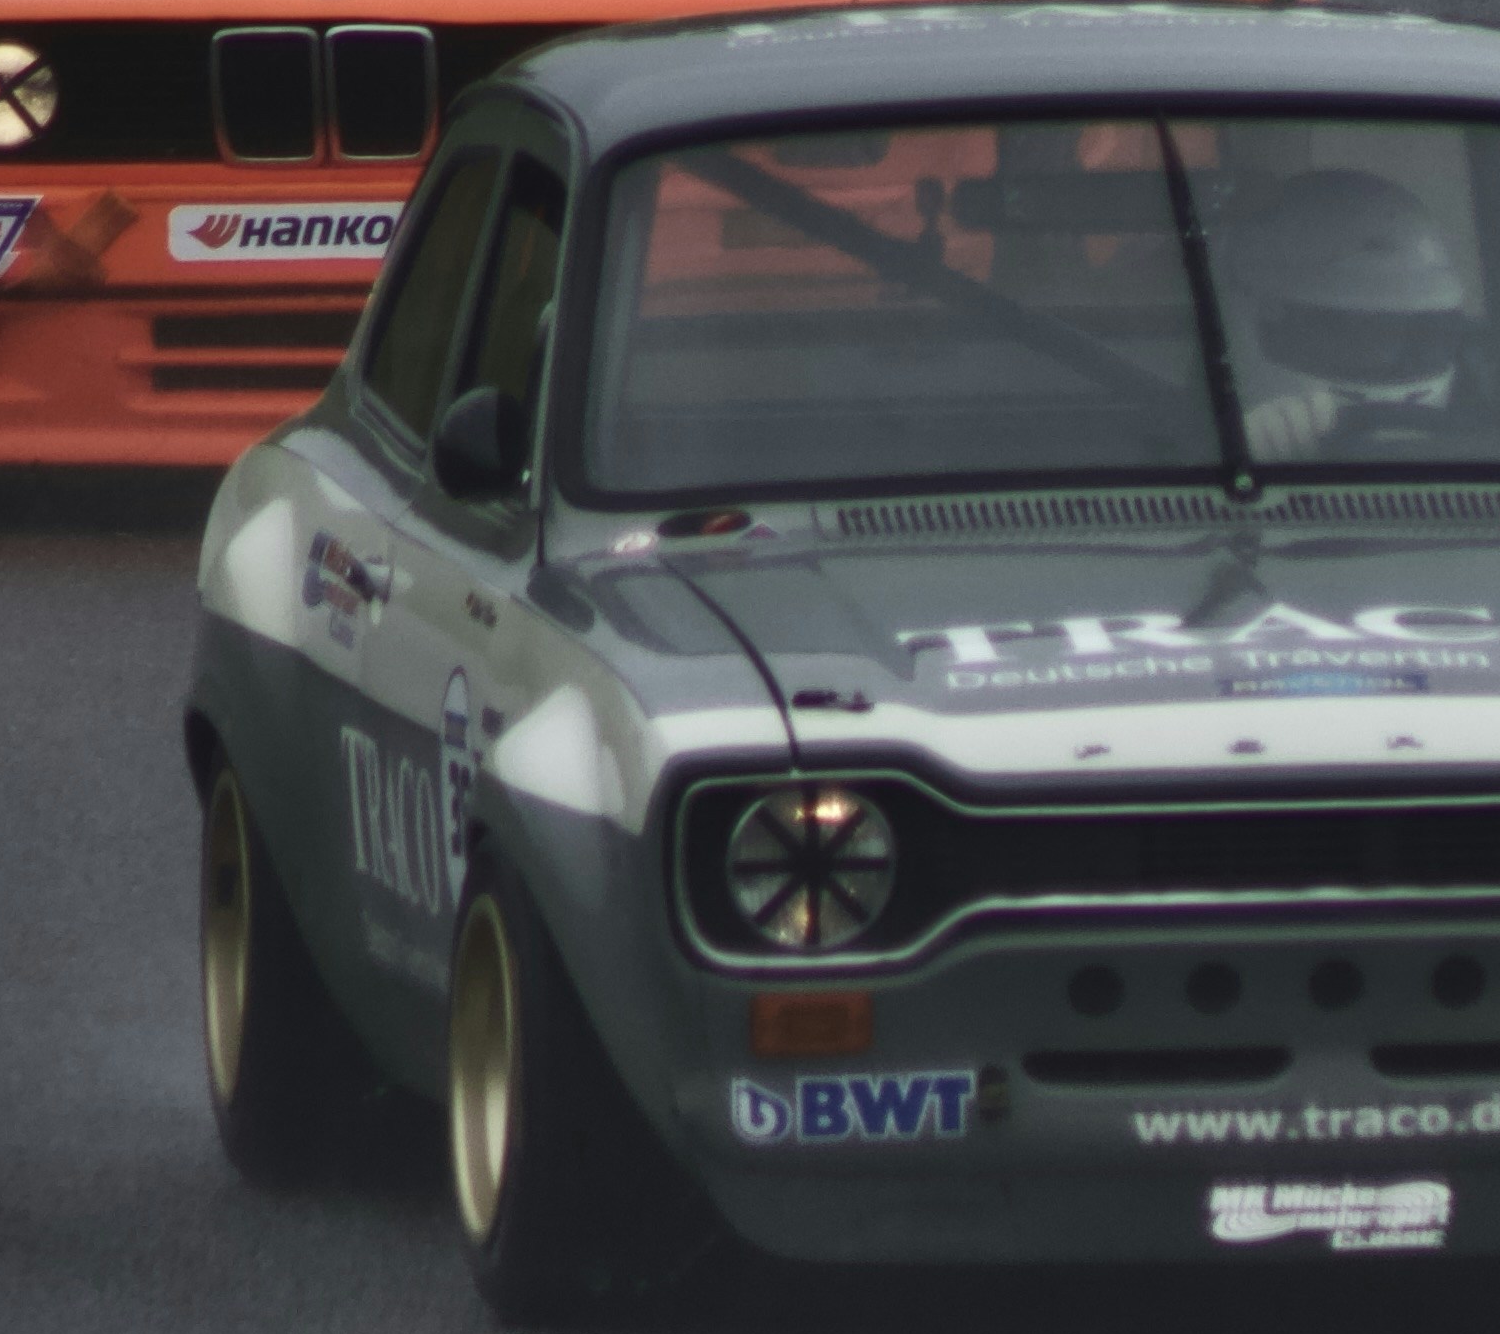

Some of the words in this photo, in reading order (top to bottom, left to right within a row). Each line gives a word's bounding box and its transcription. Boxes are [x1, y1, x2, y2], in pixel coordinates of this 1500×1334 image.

[947, 656, 1213, 689] Deutsche
[1239, 650, 1490, 669] Travertin
[799, 1073, 975, 1140] BWT
